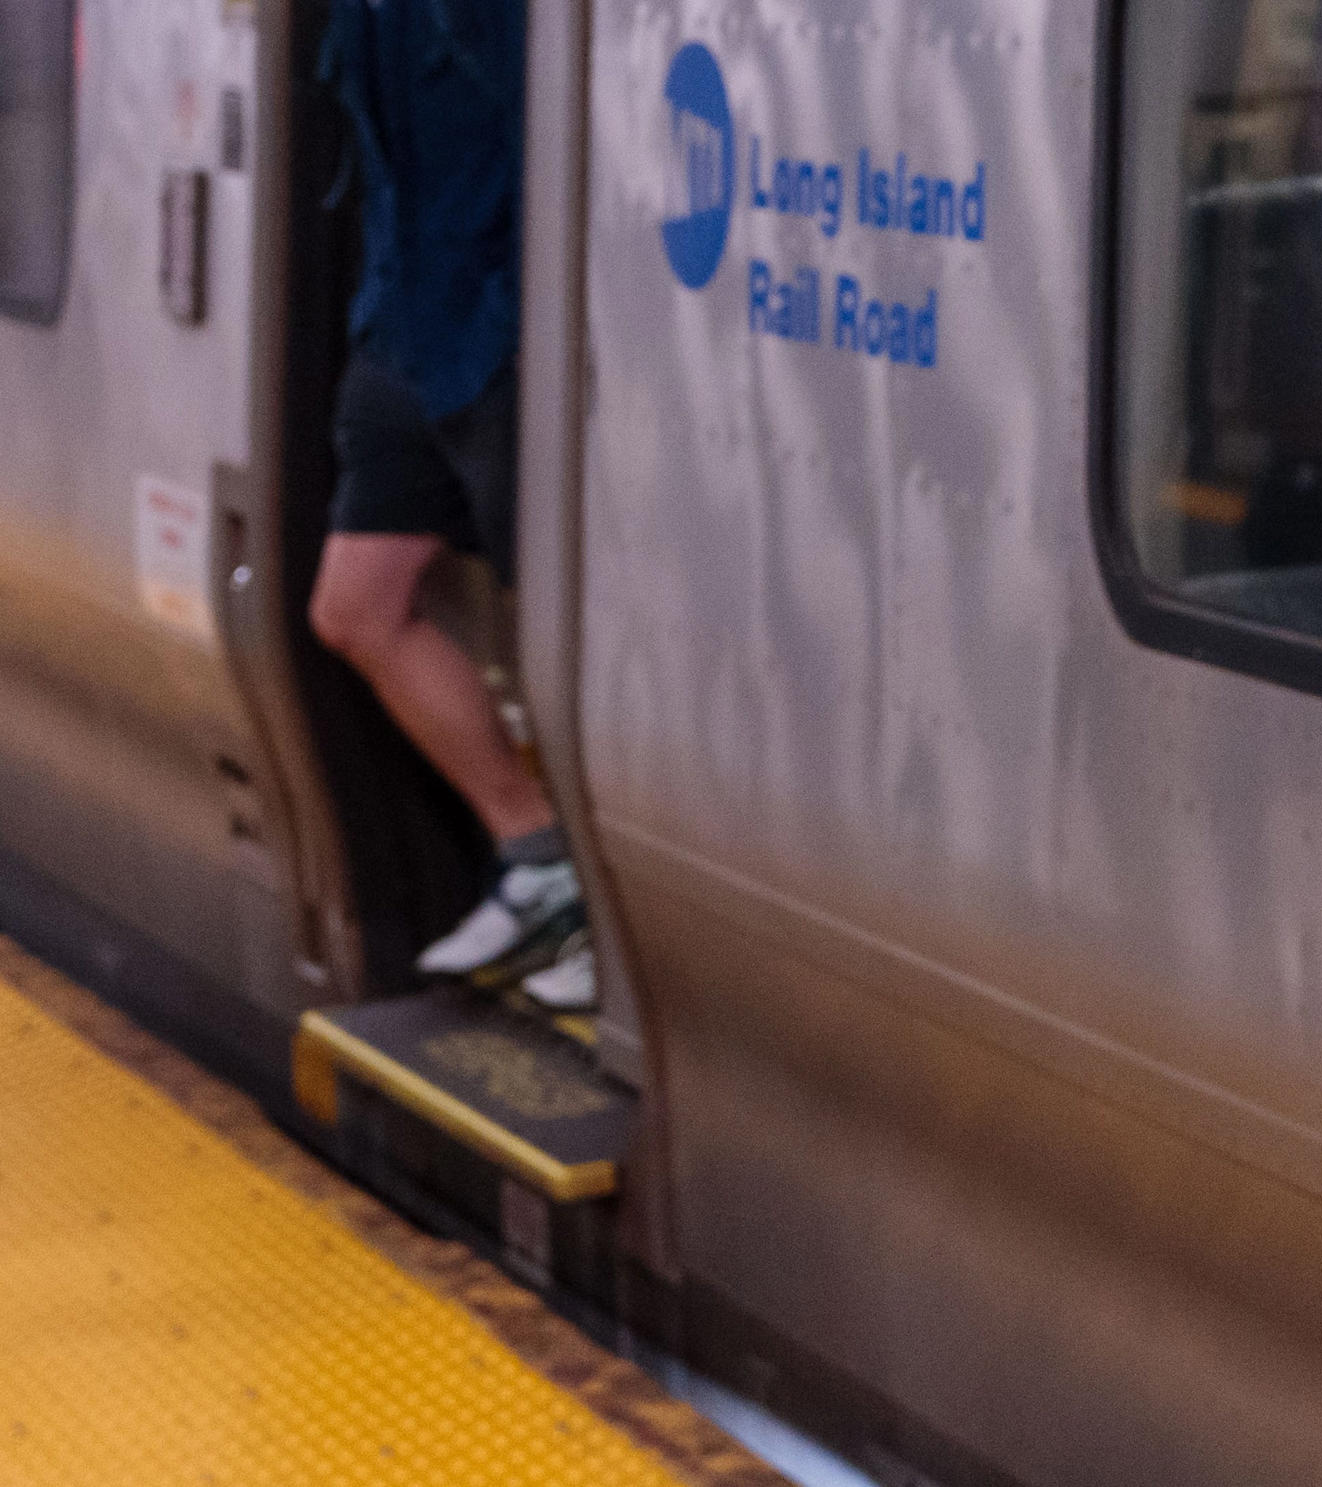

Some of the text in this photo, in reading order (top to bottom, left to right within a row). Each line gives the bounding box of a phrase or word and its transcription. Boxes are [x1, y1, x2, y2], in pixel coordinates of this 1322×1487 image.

[750, 134, 843, 238] Long
[857, 147, 986, 241] Island
[748, 259, 938, 368] Rail Road
